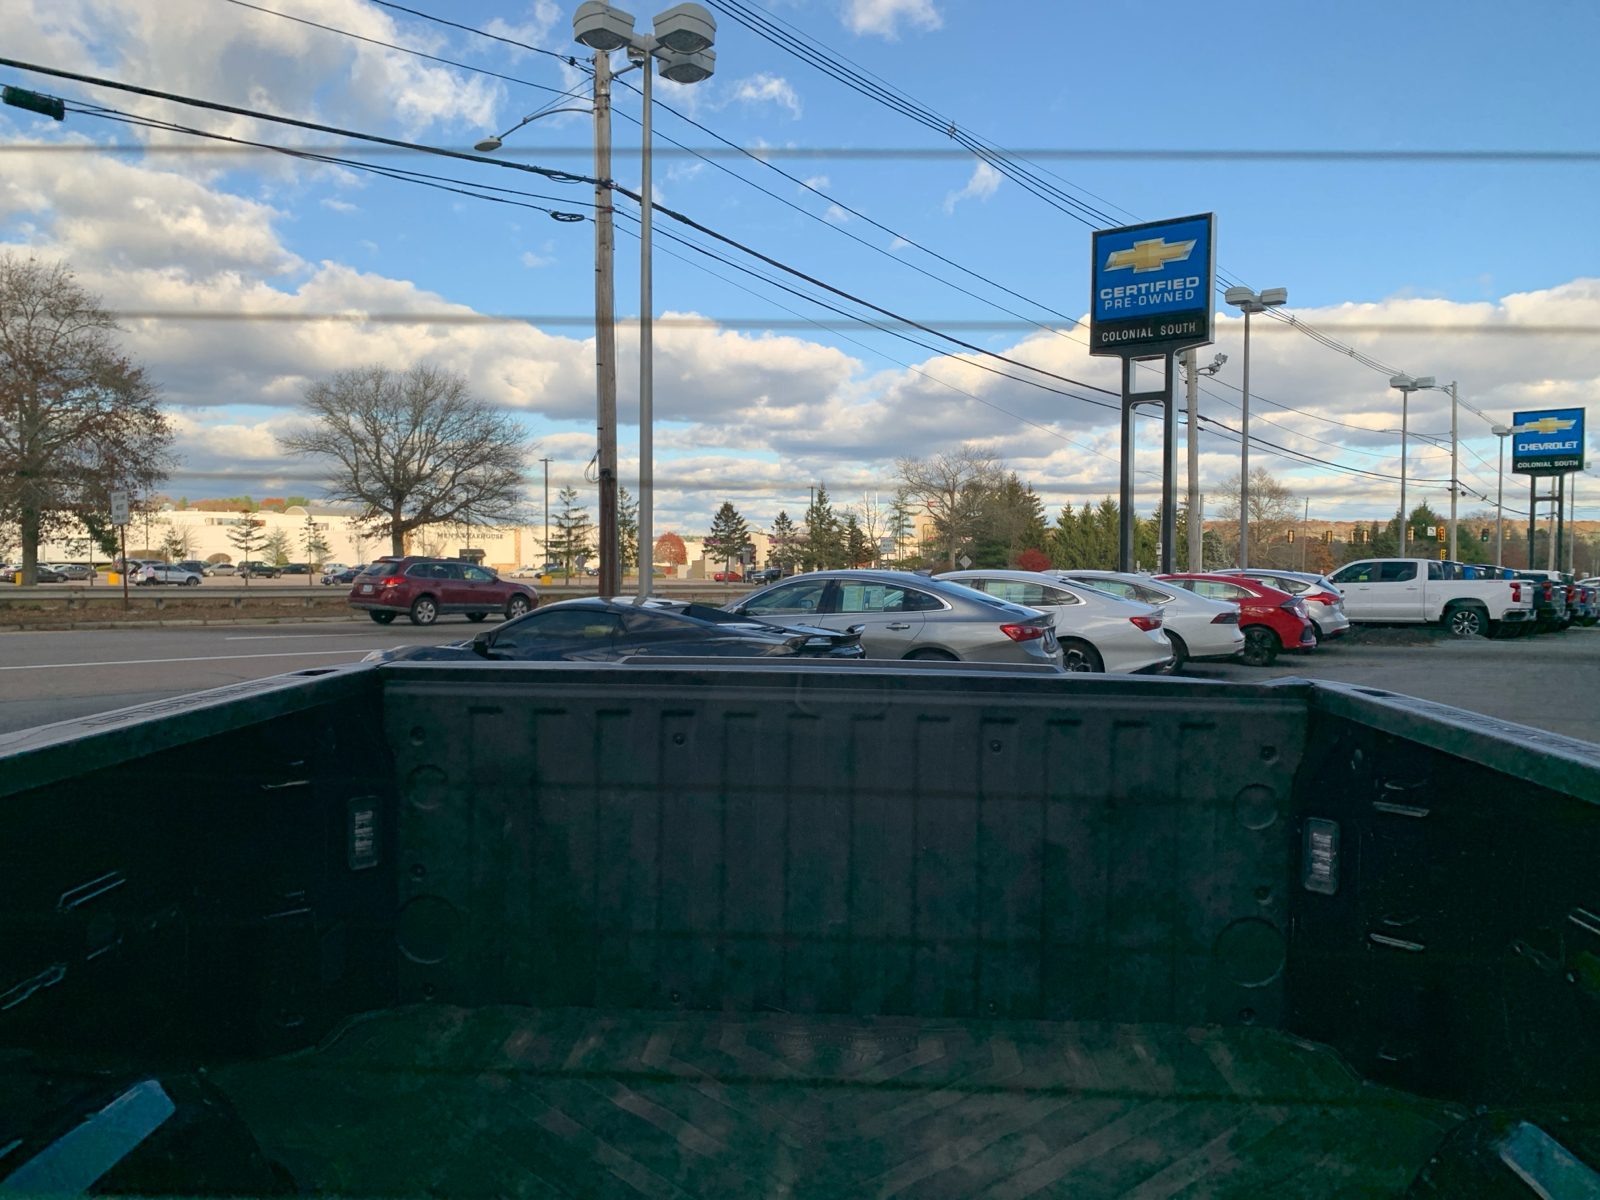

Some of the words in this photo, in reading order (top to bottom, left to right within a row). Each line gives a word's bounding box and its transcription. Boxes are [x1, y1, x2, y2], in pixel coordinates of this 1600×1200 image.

[1100, 276, 1199, 299] CERTIFIED
[1104, 290, 1194, 310] PRE-OWNED
[1102, 327, 1153, 342] COLONIAL
[1160, 322, 1196, 335] SOUTH
[1518, 441, 1578, 451] CHEVROLET
